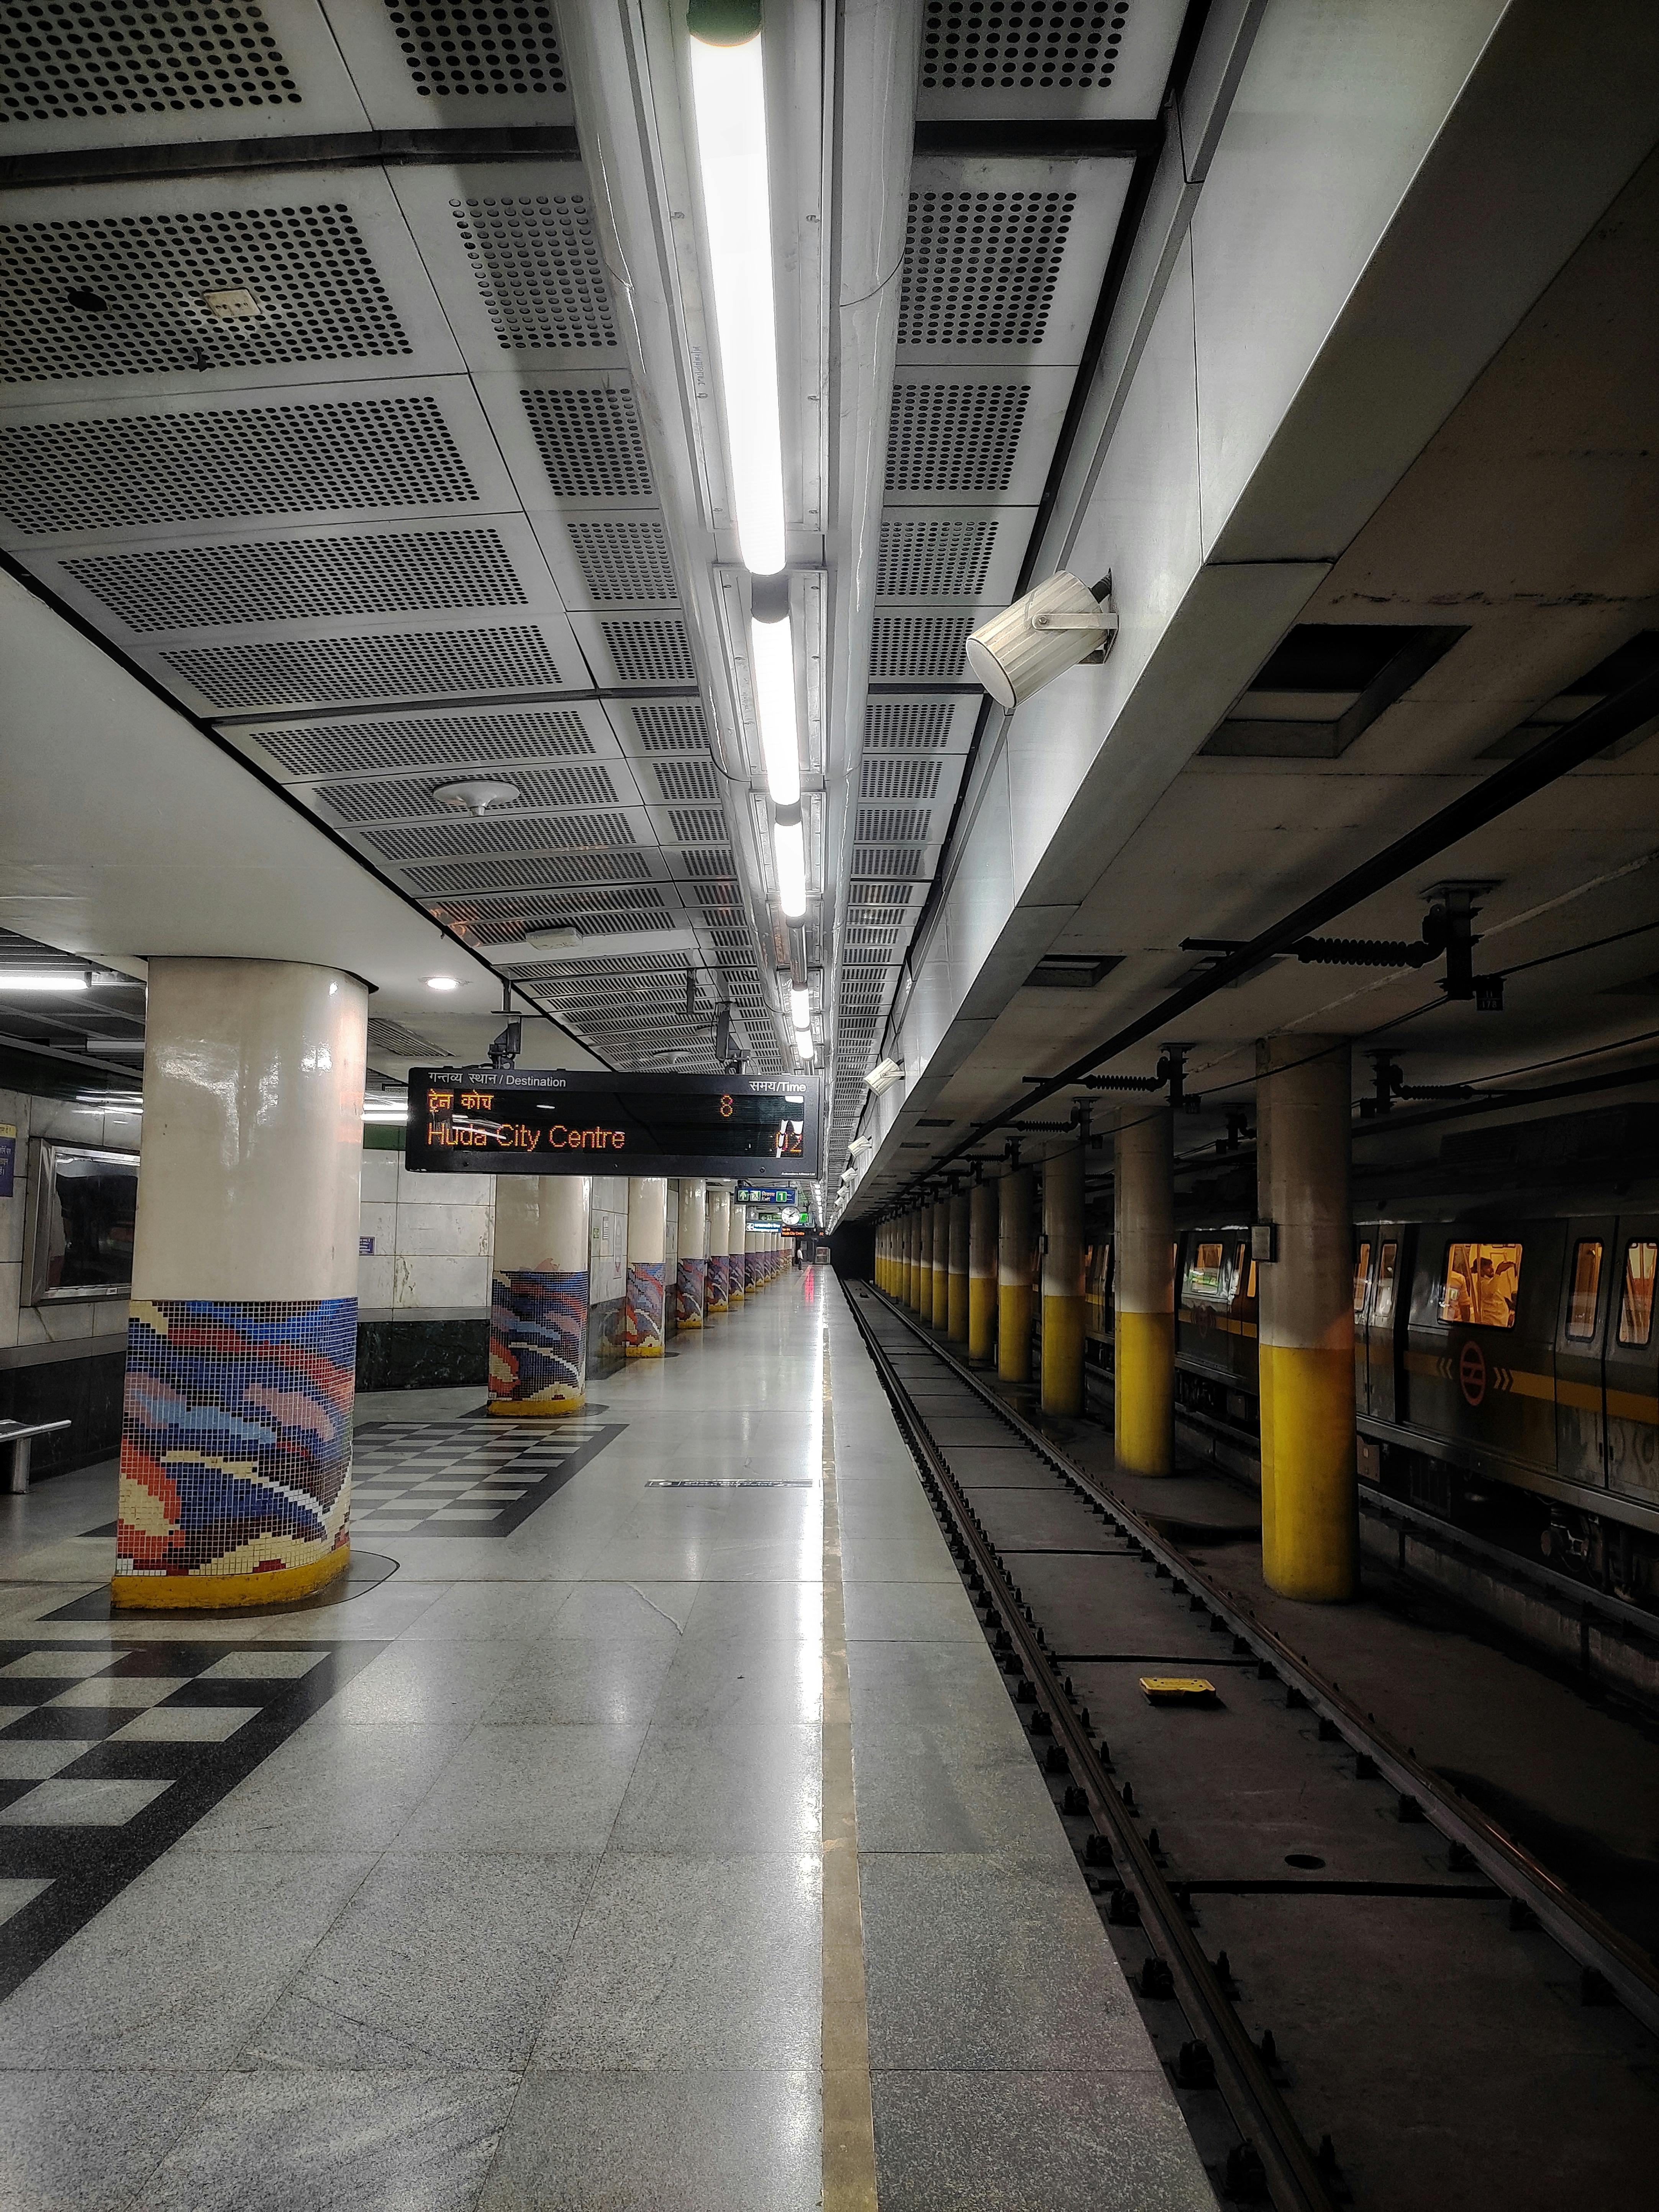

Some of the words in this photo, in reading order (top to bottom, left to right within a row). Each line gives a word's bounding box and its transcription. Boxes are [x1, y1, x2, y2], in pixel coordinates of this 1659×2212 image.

[428, 1072, 463, 1083] गन्तव्य
[468, 1072, 497, 1084] स्थान
[506, 1075, 566, 1087] Destination
[461, 1088, 494, 1110] कोच
[719, 1094, 734, 1117] 8
[427, 1122, 487, 1146] Huda
[496, 1123, 541, 1152] City
[549, 1125, 626, 1148] Centre
[779, 1193, 783, 1201] 1
